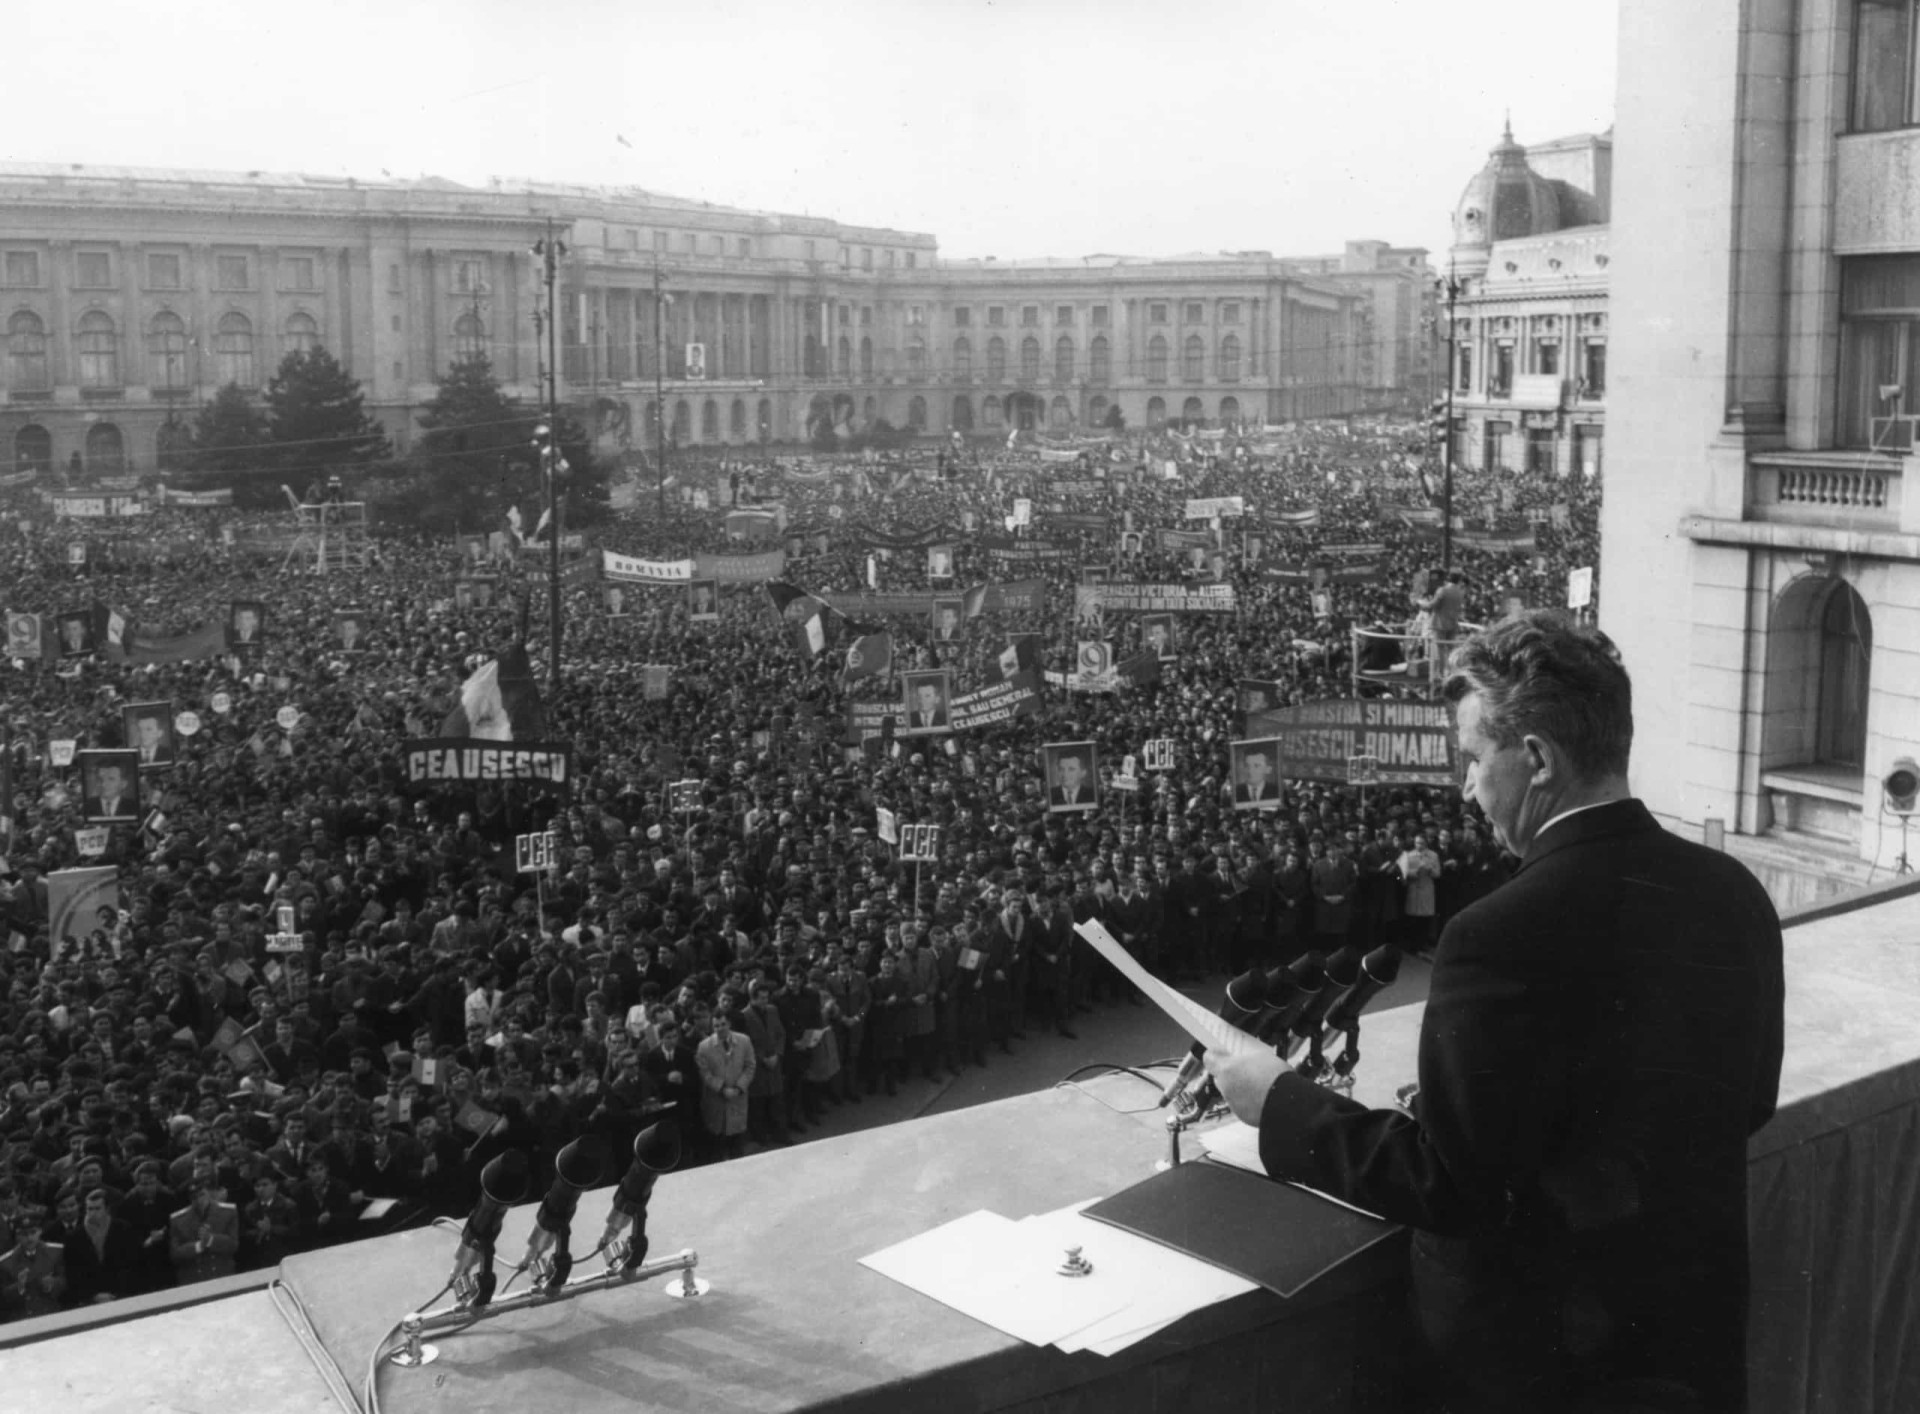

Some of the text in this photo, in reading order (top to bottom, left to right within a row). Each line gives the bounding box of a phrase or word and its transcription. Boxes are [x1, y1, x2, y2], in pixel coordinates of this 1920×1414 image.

[1140, 584, 1188, 598] VICTORIA
[1080, 643, 1108, 681] 9
[409, 748, 565, 782] CEAUSESCU
